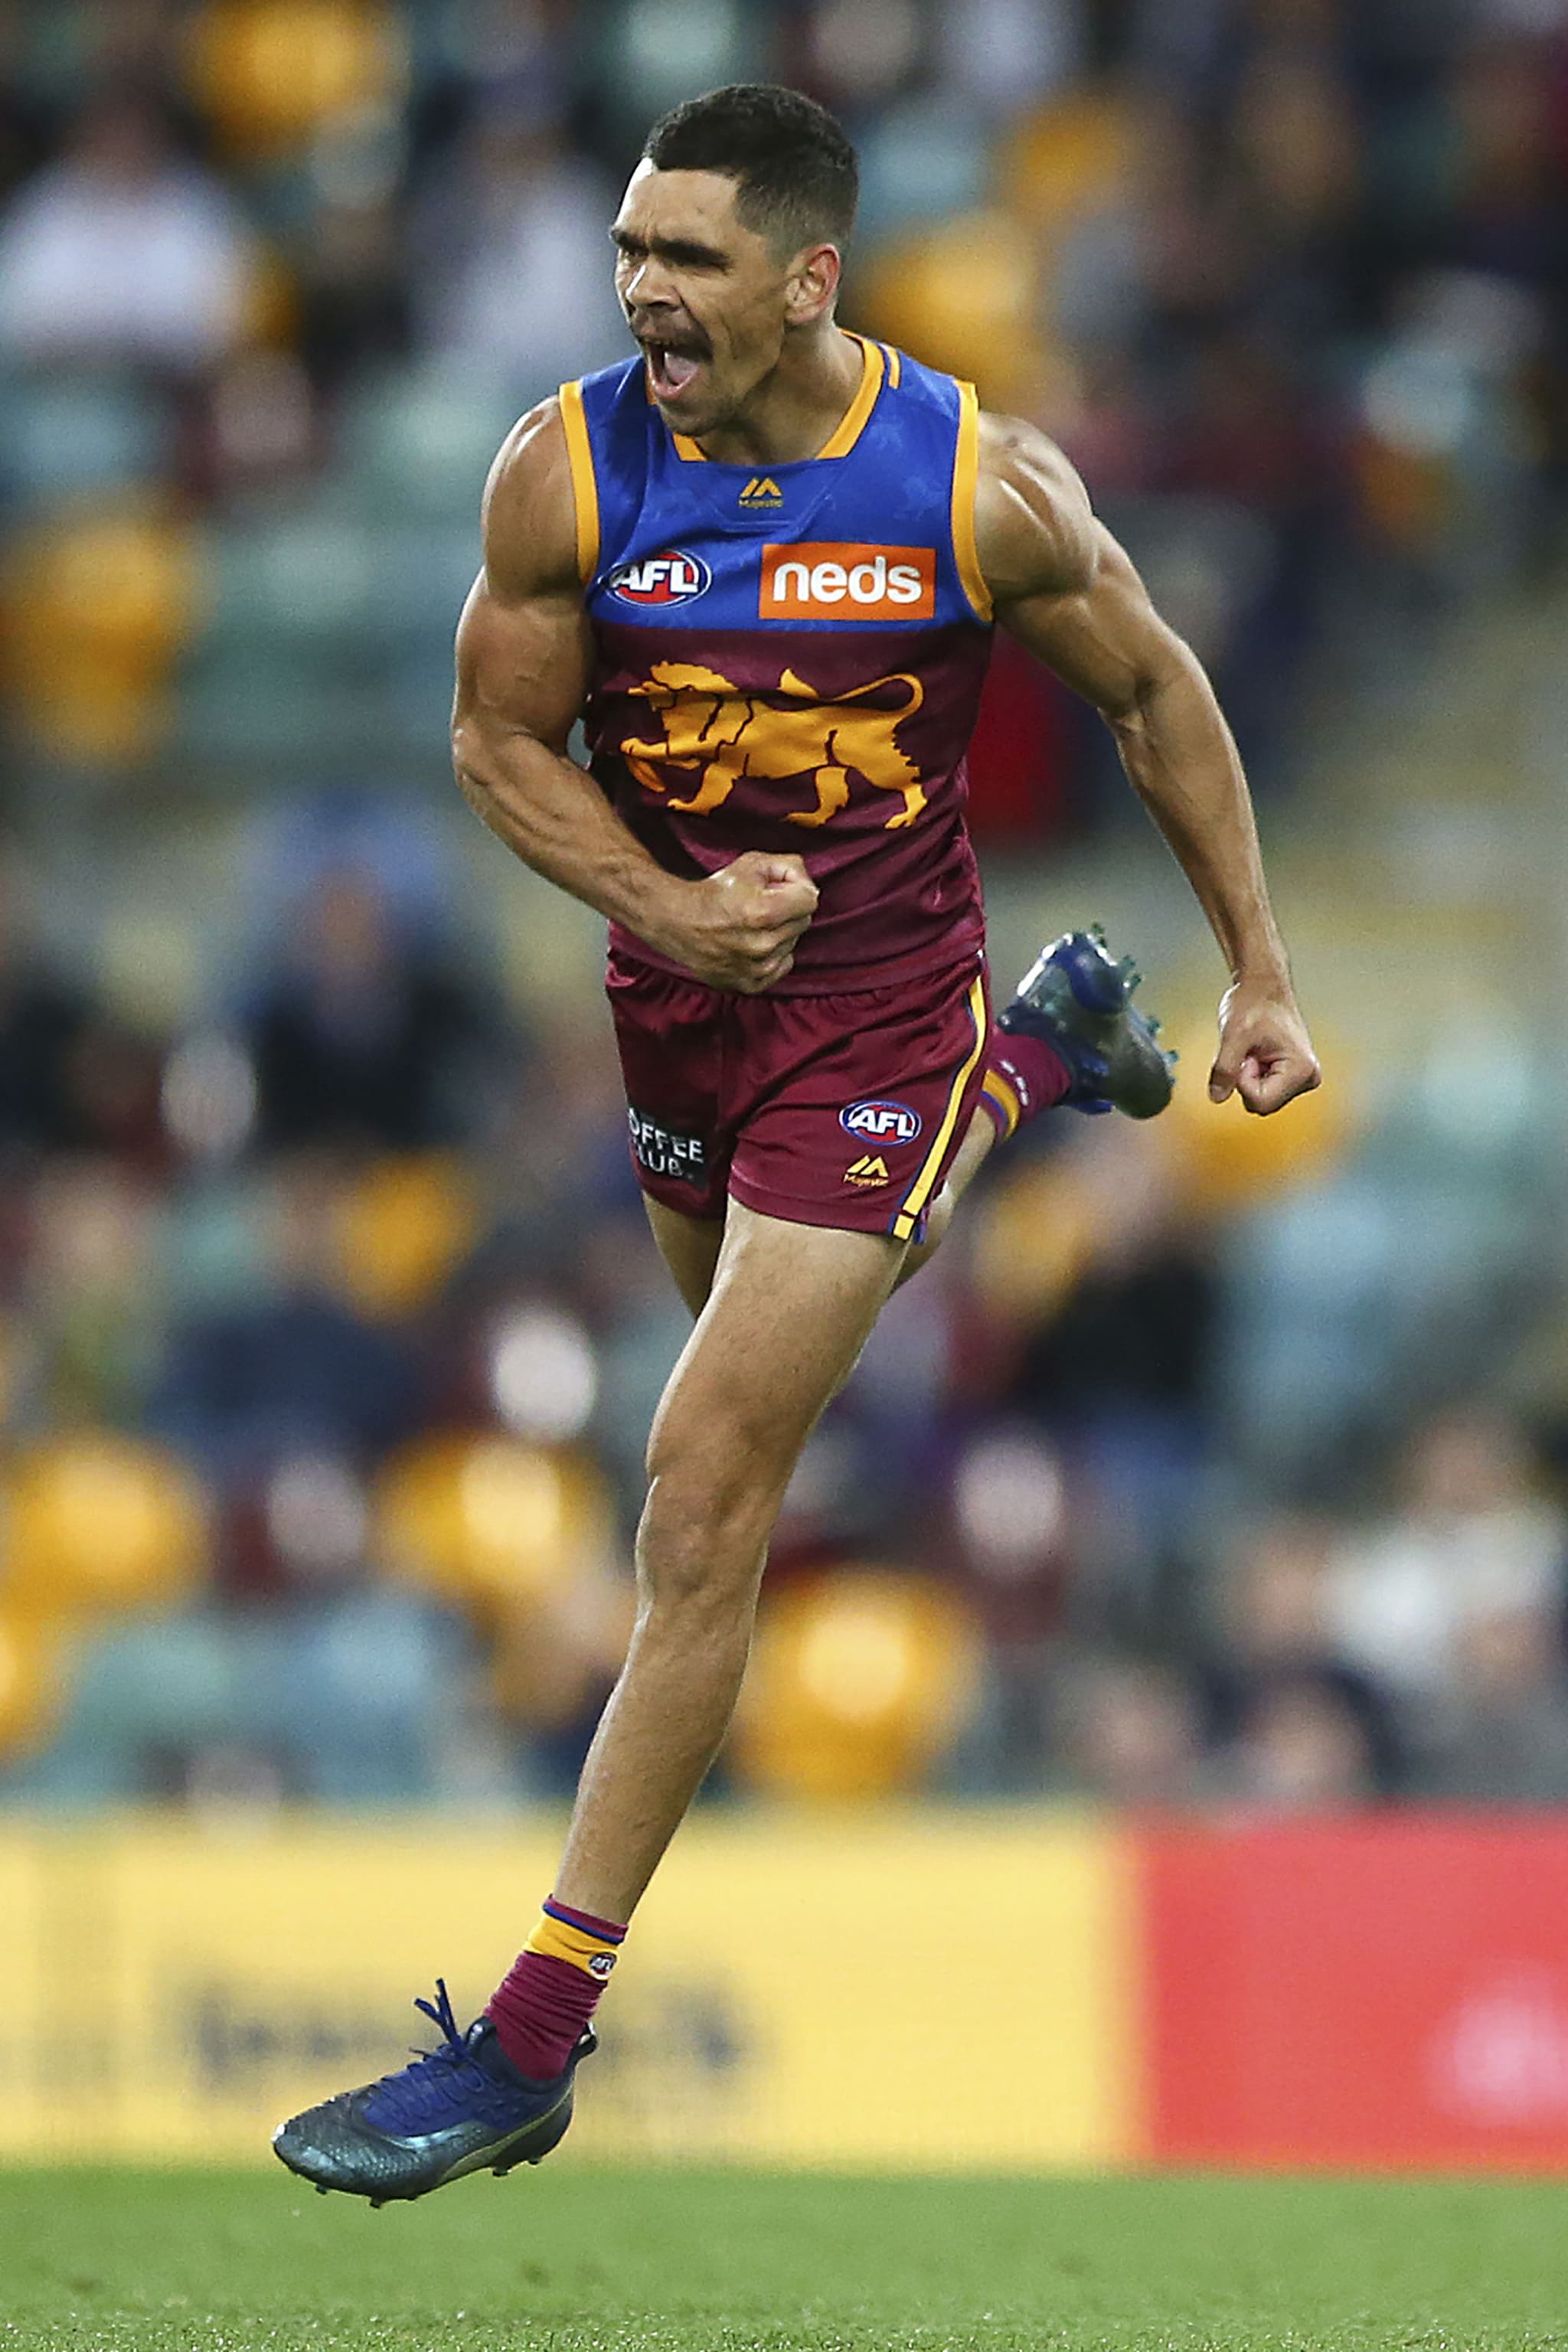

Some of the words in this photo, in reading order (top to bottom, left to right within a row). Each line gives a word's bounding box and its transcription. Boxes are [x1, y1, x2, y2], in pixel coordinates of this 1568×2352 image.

[609, 560, 698, 593] AFL
[773, 557, 922, 603] neds
[628, 1107, 705, 1164] OFFEE
[847, 1109, 914, 1138] AFL
